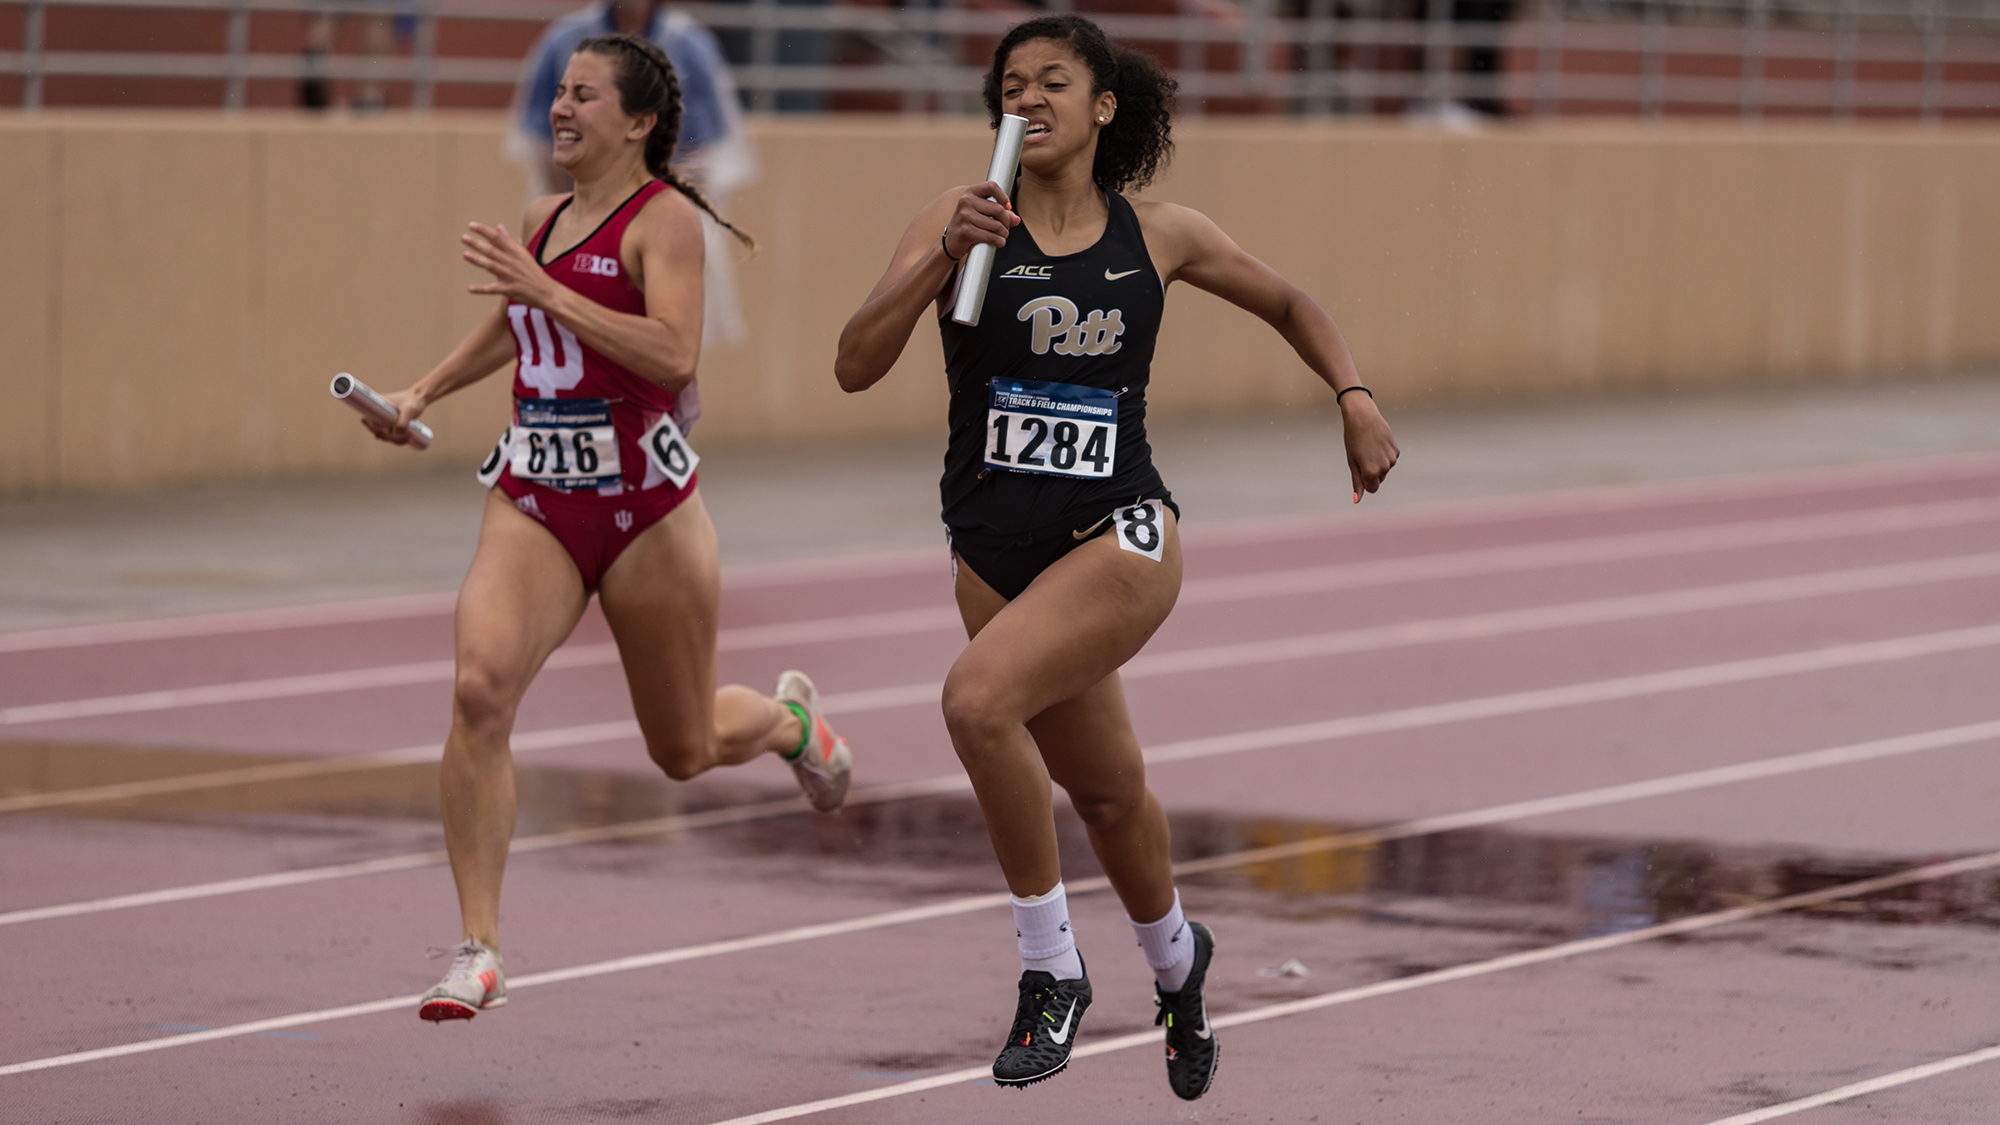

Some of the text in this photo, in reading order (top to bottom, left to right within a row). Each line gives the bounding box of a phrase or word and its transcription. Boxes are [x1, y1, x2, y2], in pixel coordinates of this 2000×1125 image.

[1005, 265, 1054, 276] ACC
[1017, 295, 1126, 357] Pitt
[1009, 397, 1031, 407] TRACK
[1031, 400, 1037, 408] &
[1037, 400, 1056, 410] FIELD
[1056, 402, 1113, 417] CHAMPIONSHIPS
[528, 431, 599, 474] 616
[652, 425, 690, 477] 6
[991, 414, 1110, 473] 1284
[1122, 503, 1160, 552] 8
